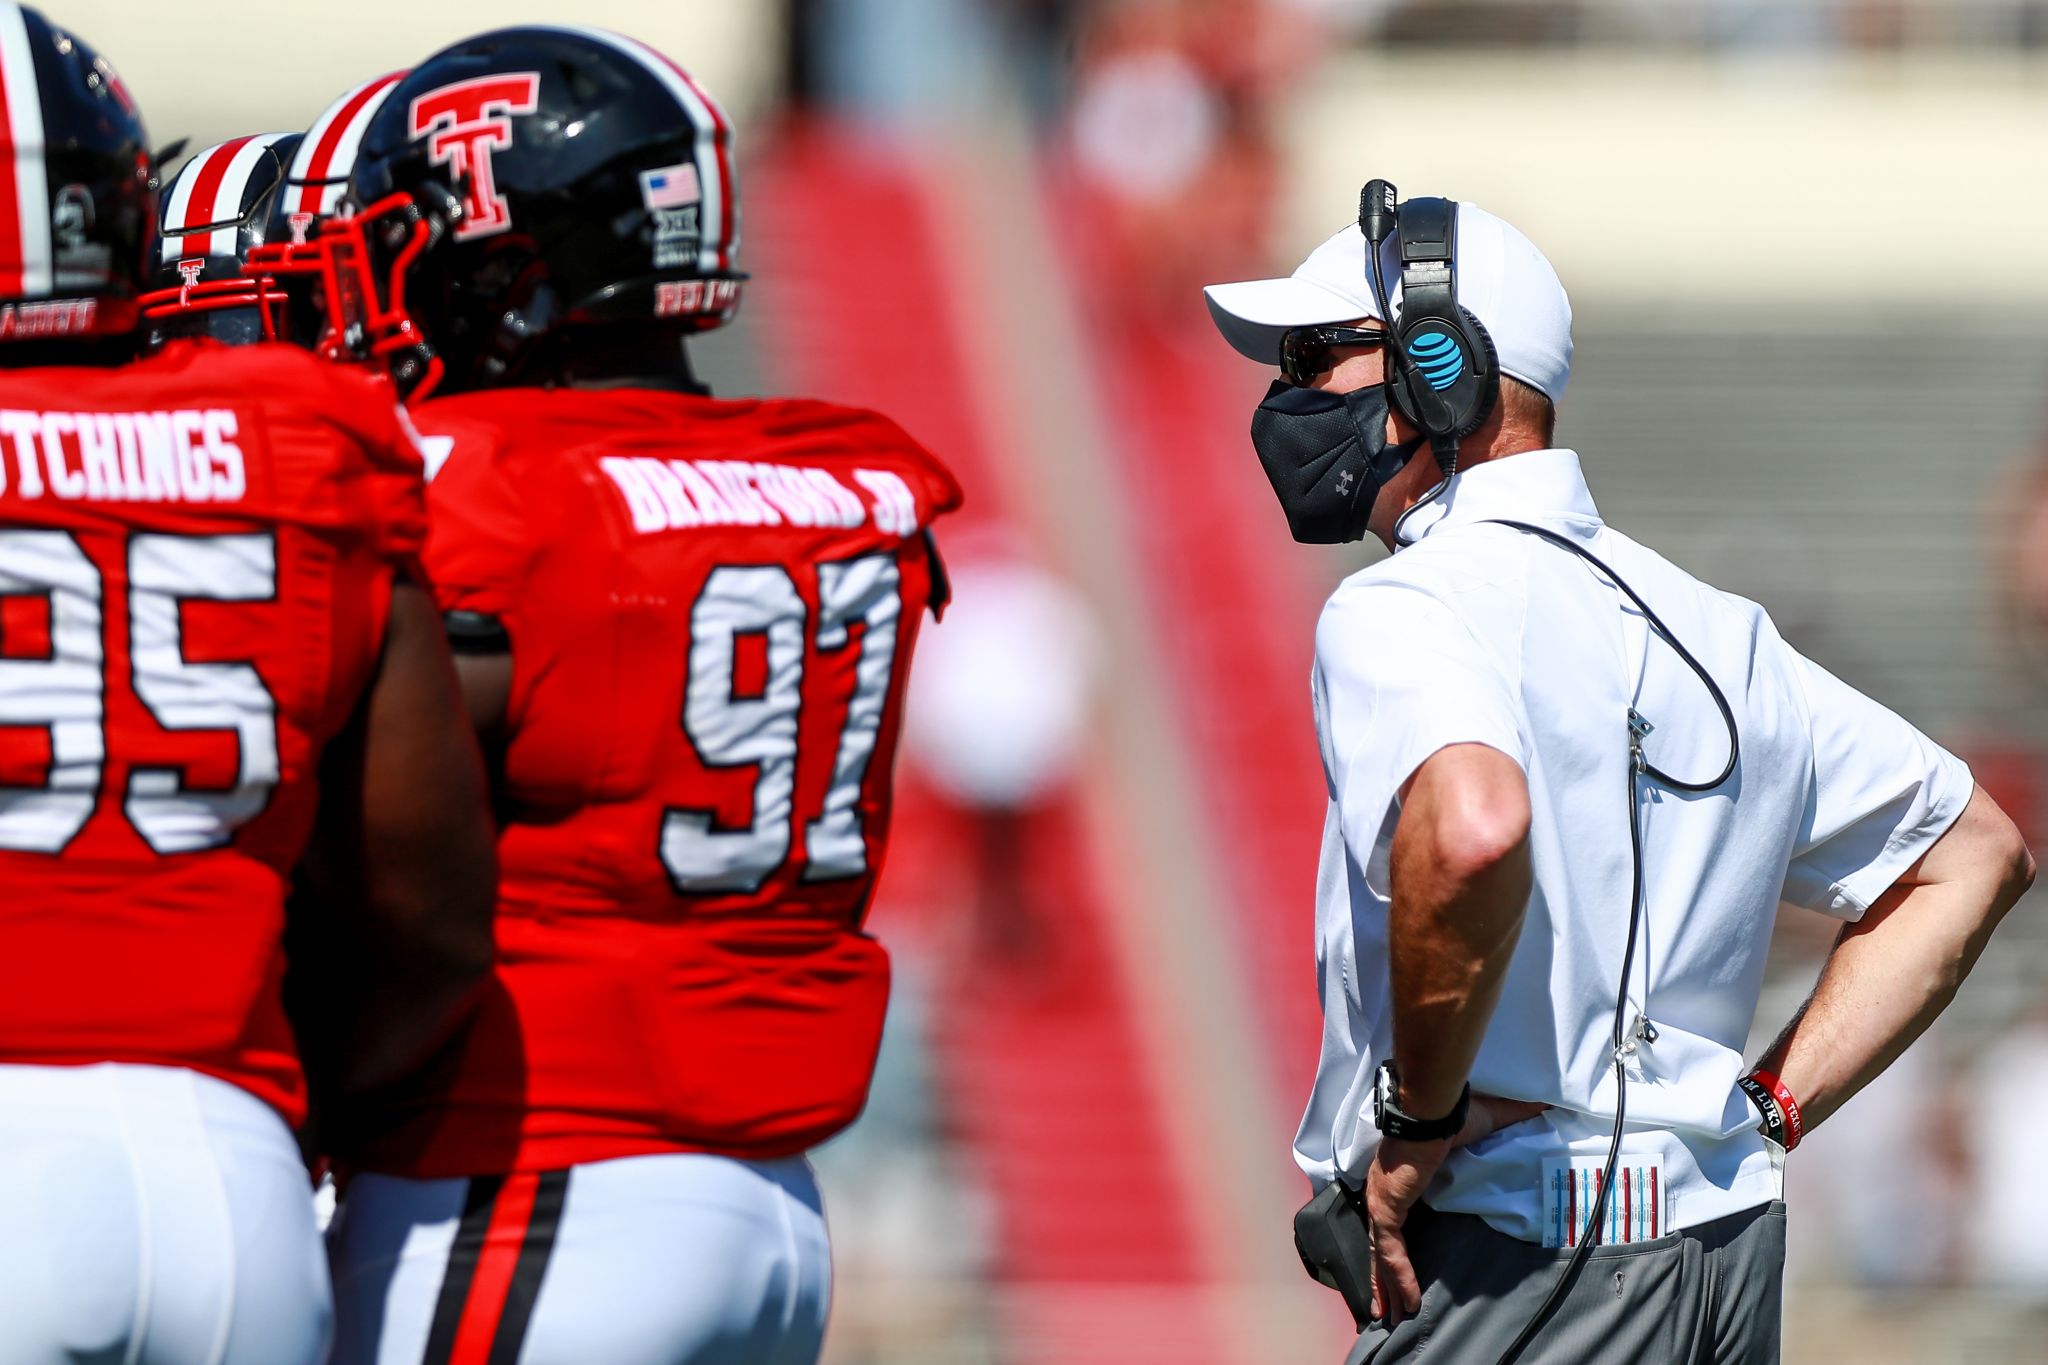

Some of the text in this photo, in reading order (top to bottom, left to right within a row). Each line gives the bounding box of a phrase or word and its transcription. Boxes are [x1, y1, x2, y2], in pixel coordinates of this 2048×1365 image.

[1384, 185, 1395, 213] AT&T
[0, 408, 246, 502] TCHINGS
[658, 552, 901, 895] 97
